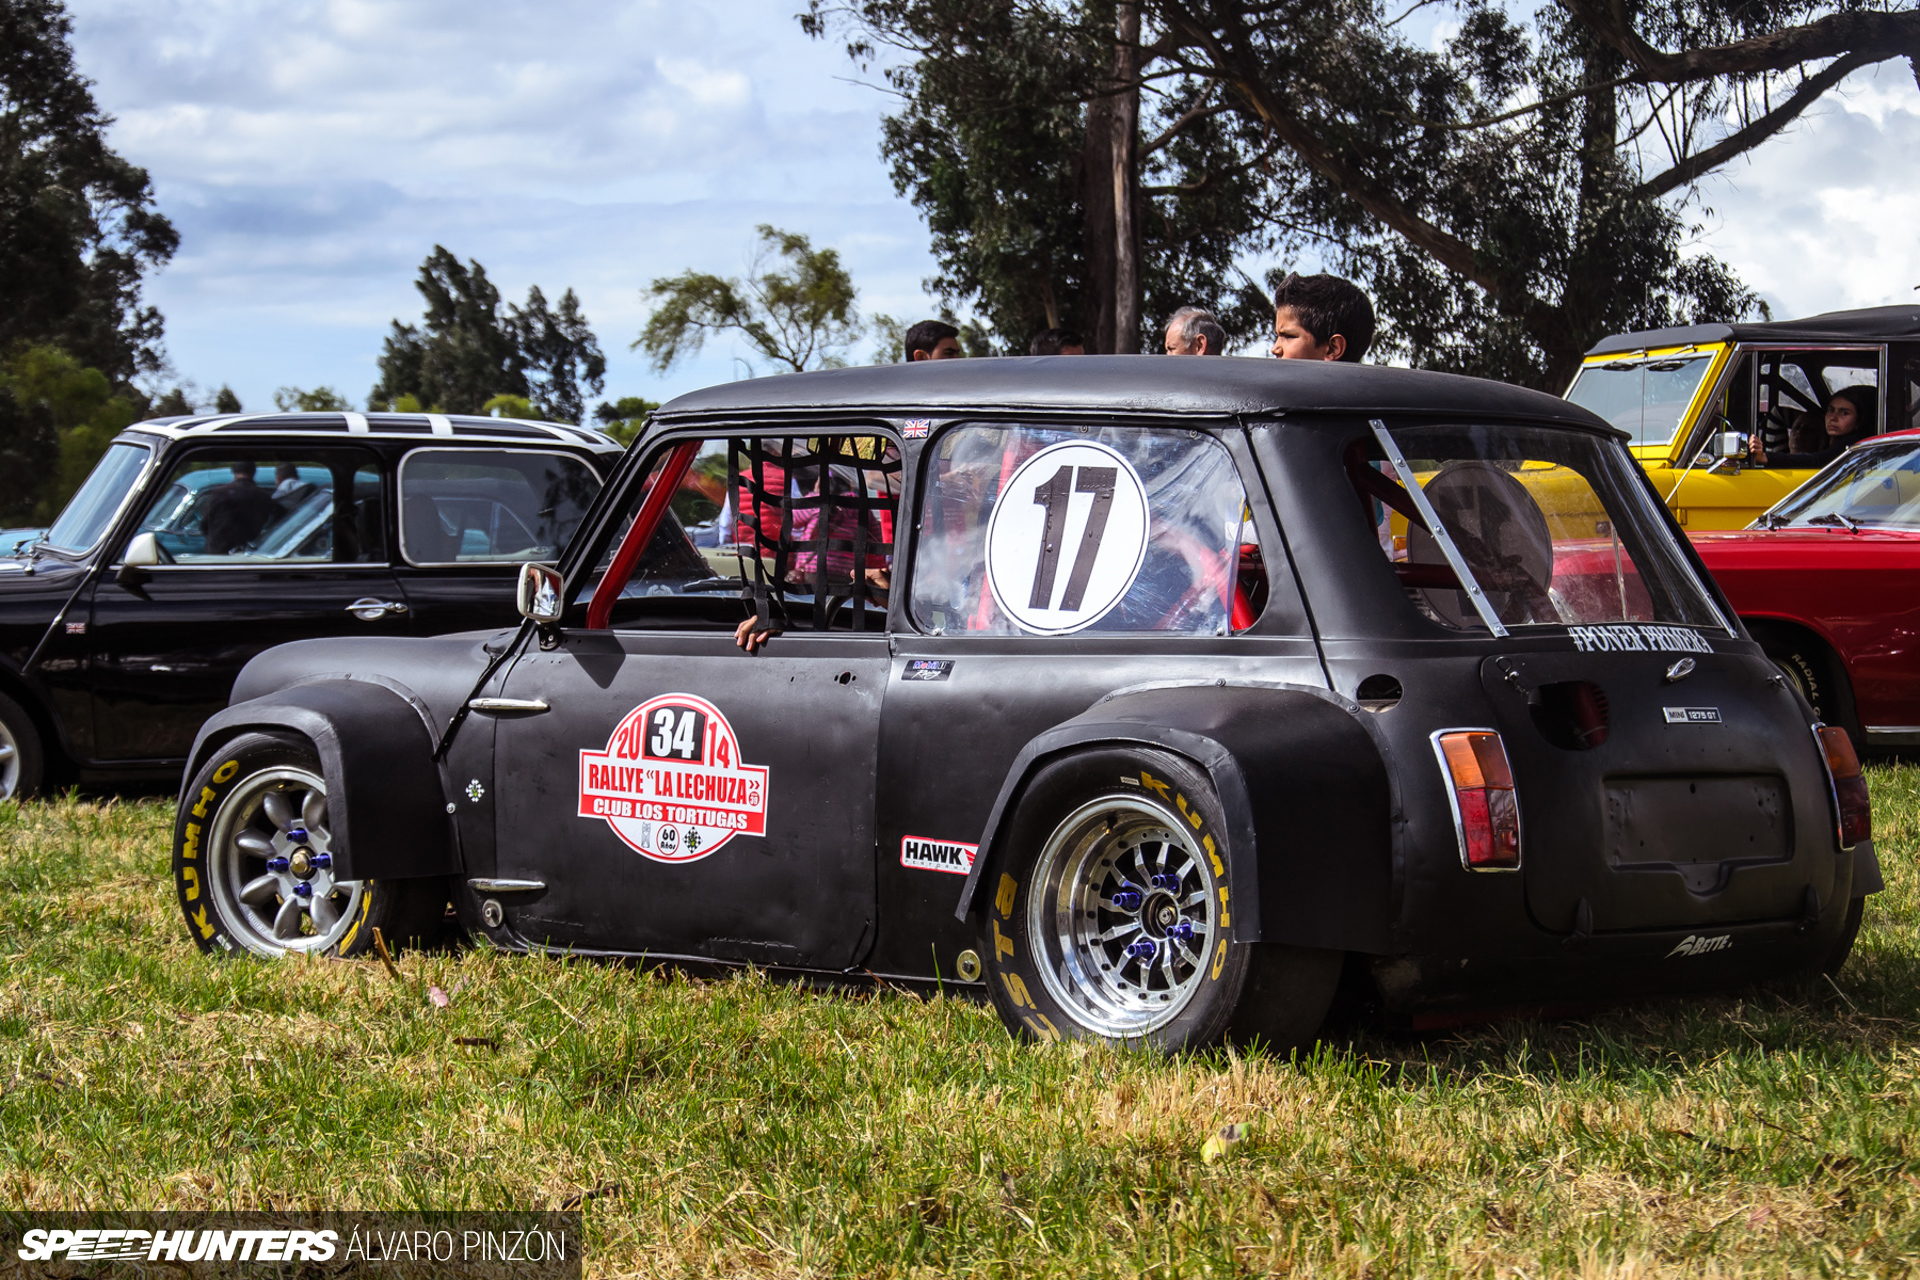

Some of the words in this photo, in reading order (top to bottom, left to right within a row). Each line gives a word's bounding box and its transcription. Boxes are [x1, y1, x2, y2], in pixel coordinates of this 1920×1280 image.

[1028, 465, 1118, 612] 17
[1567, 625, 1649, 652] #PONER
[1637, 626, 1714, 653] PRIMERA
[1792, 653, 1819, 700] RADIAL
[1669, 711, 1686, 719] MINI
[1688, 711, 1707, 720] 1275
[1706, 711, 1717, 720] GT
[616, 713, 643, 761] 20
[651, 708, 697, 759] 34
[708, 721, 731, 768] 14
[589, 763, 644, 794] RALLYE
[593, 798, 632, 818] CLUB
[635, 802, 664, 821] LOS
[666, 805, 748, 830] TORTUGAS
[182, 759, 239, 941] KUMHO
[661, 829, 676, 843] 60
[906, 841, 963, 866] HAWK
[1141, 771, 1230, 981] KUMHO
